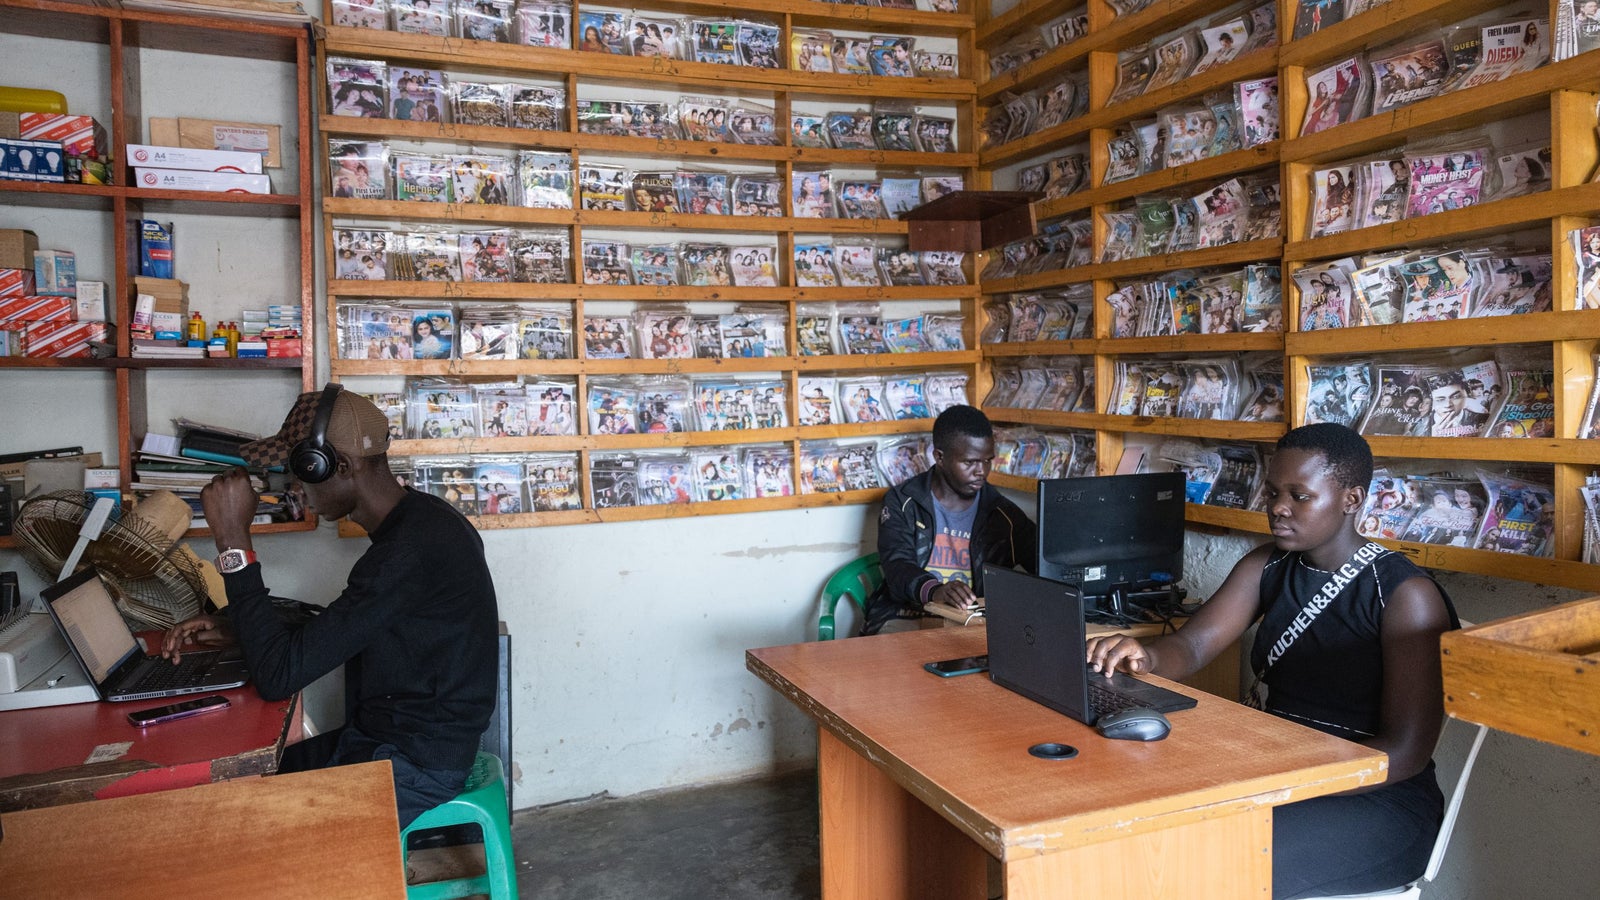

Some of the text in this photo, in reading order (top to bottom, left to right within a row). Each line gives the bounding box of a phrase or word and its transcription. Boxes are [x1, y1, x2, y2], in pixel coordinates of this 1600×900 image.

[1487, 25, 1502, 38] FREYA
[1485, 46, 1519, 66] QUEEN
[1420, 169, 1474, 184] MONEY HEIST
[403, 182, 439, 195] Heroes
[1505, 404, 1527, 412] The
[1498, 520, 1536, 532] FIRST
[1500, 529, 1527, 541] KILL
